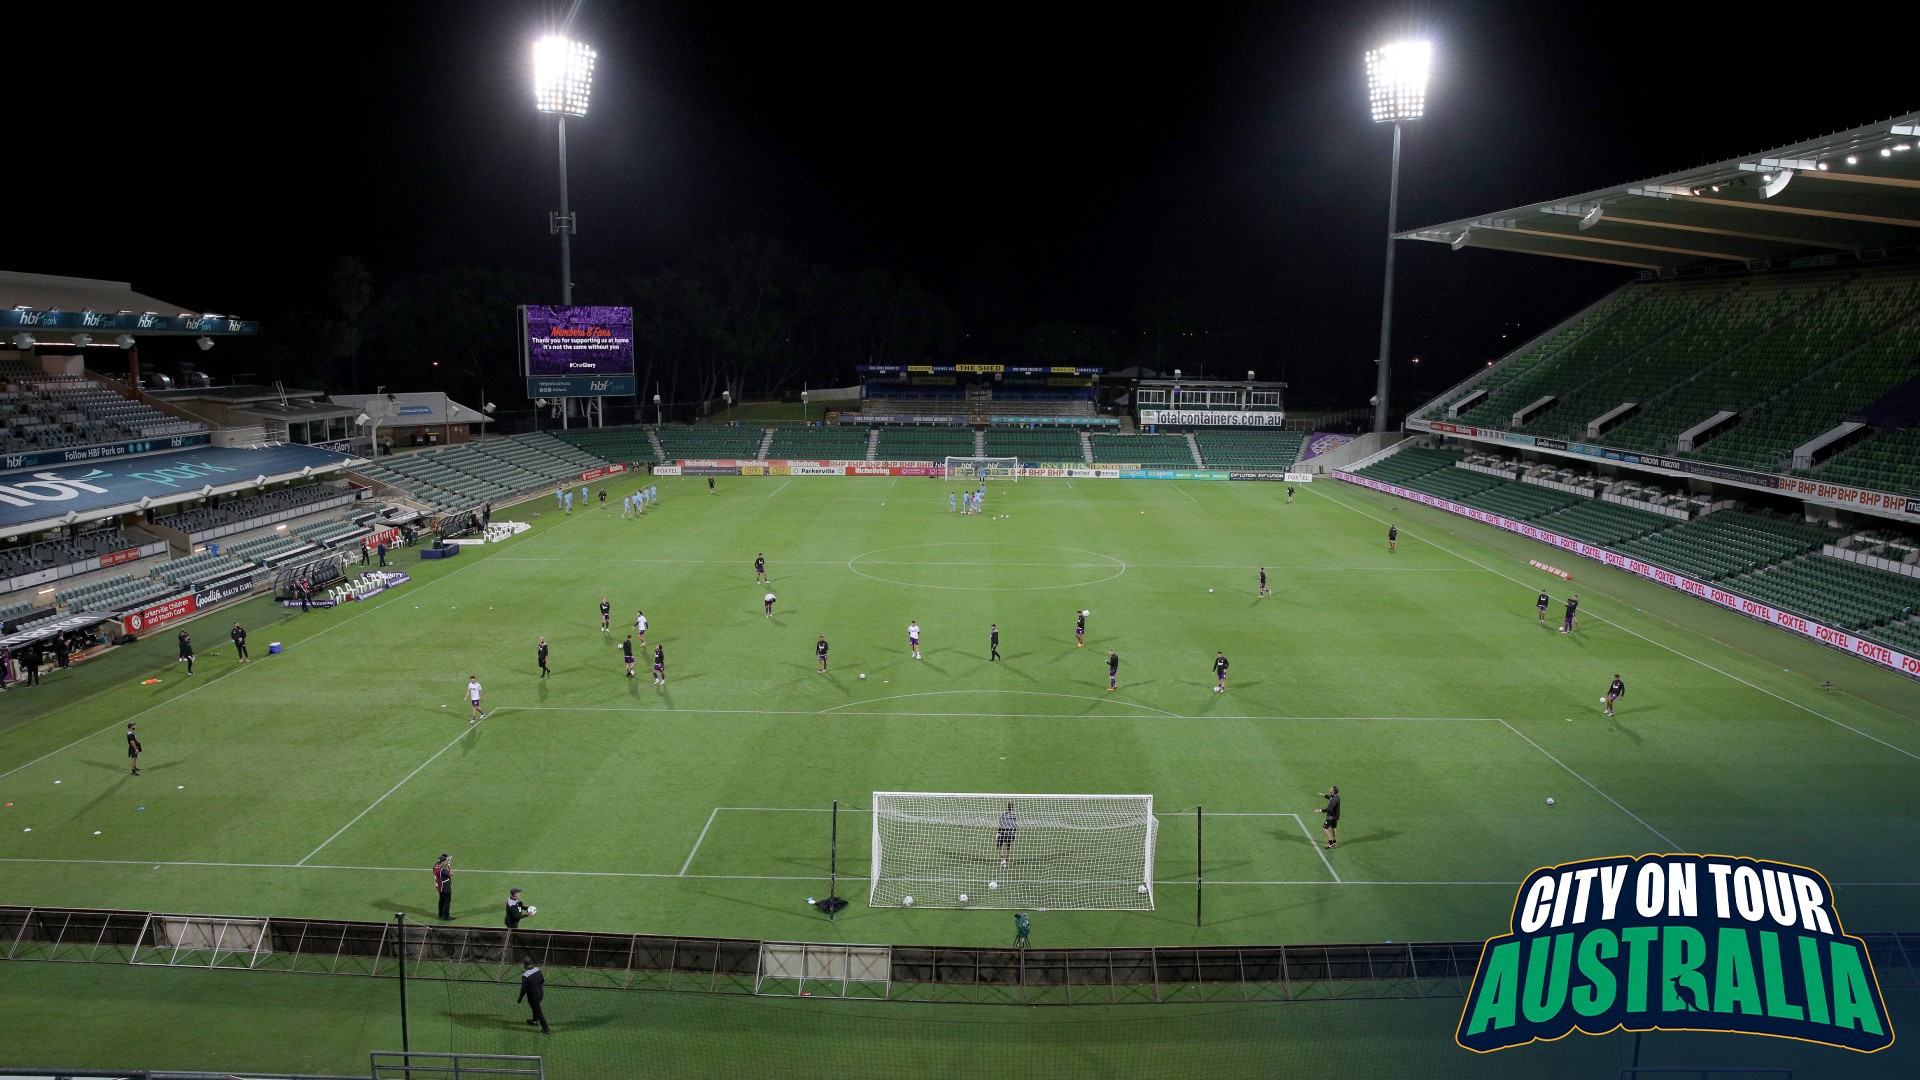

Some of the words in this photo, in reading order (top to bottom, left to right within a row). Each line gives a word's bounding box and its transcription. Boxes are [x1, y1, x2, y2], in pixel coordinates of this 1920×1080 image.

[20, 312, 41, 325] hbf
[43, 317, 58, 327] park
[83, 313, 101, 326] hbf
[138, 317, 154, 328] hbf
[186, 319, 201, 330] hbf
[229, 320, 243, 331] hbf
[551, 326, 585, 337] Members
[587, 327, 593, 336] &
[594, 327, 611, 336] Fans
[591, 381, 609, 390] hbf
[1156, 411, 1280, 426] Totalcontainers.com.au
[65, 452, 87, 460] Follow
[88, 449, 100, 457] HBF
[101, 447, 115, 456] Park
[6, 456, 22, 468] hbf
[1641, 456, 1659, 465] macron
[1661, 460, 1680, 469] macron
[126, 461, 237, 487] park
[855, 467, 889, 475] Nicheliving
[1780, 478, 1796, 491] BHP
[1798, 481, 1816, 494] BHP
[1818, 485, 1837, 498] BHP
[1838, 488, 1858, 502] BHP
[1860, 492, 1881, 506] BHP
[1883, 496, 1905, 510] BHP
[1453, 504, 1465, 515] FOXTEL
[1468, 509, 1482, 520] FOXTEL
[1485, 514, 1500, 525] FOXTEL
[1504, 519, 1518, 531] FOXTEL
[1521, 525, 1537, 537] FOXTEL
[1540, 531, 1557, 544] FOXTEL
[1560, 538, 1578, 551] FOXTEL
[1582, 545, 1600, 558] FOXTEL
[1605, 552, 1625, 567] FOXTEL
[1629, 560, 1650, 575] FOXTEL
[1654, 569, 1676, 585] FOXTEL
[1681, 579, 1705, 596] FOXTEL
[1711, 589, 1736, 607] FOXTEL
[1742, 600, 1770, 619] FOXTEL
[1777, 612, 1808, 633] FOXTEL
[1816, 625, 1848, 648] FOXTEL
[1857, 640, 1892, 664] FOXTEL
[195, 589, 221, 607] Goodlife
[222, 588, 239, 597] HEALTH
[239, 582, 253, 591] CLUBS
[144, 606, 168, 618] arkerville
[169, 599, 188, 610] Children
[160, 612, 173, 621] Youth
[174, 607, 186, 616] Care
